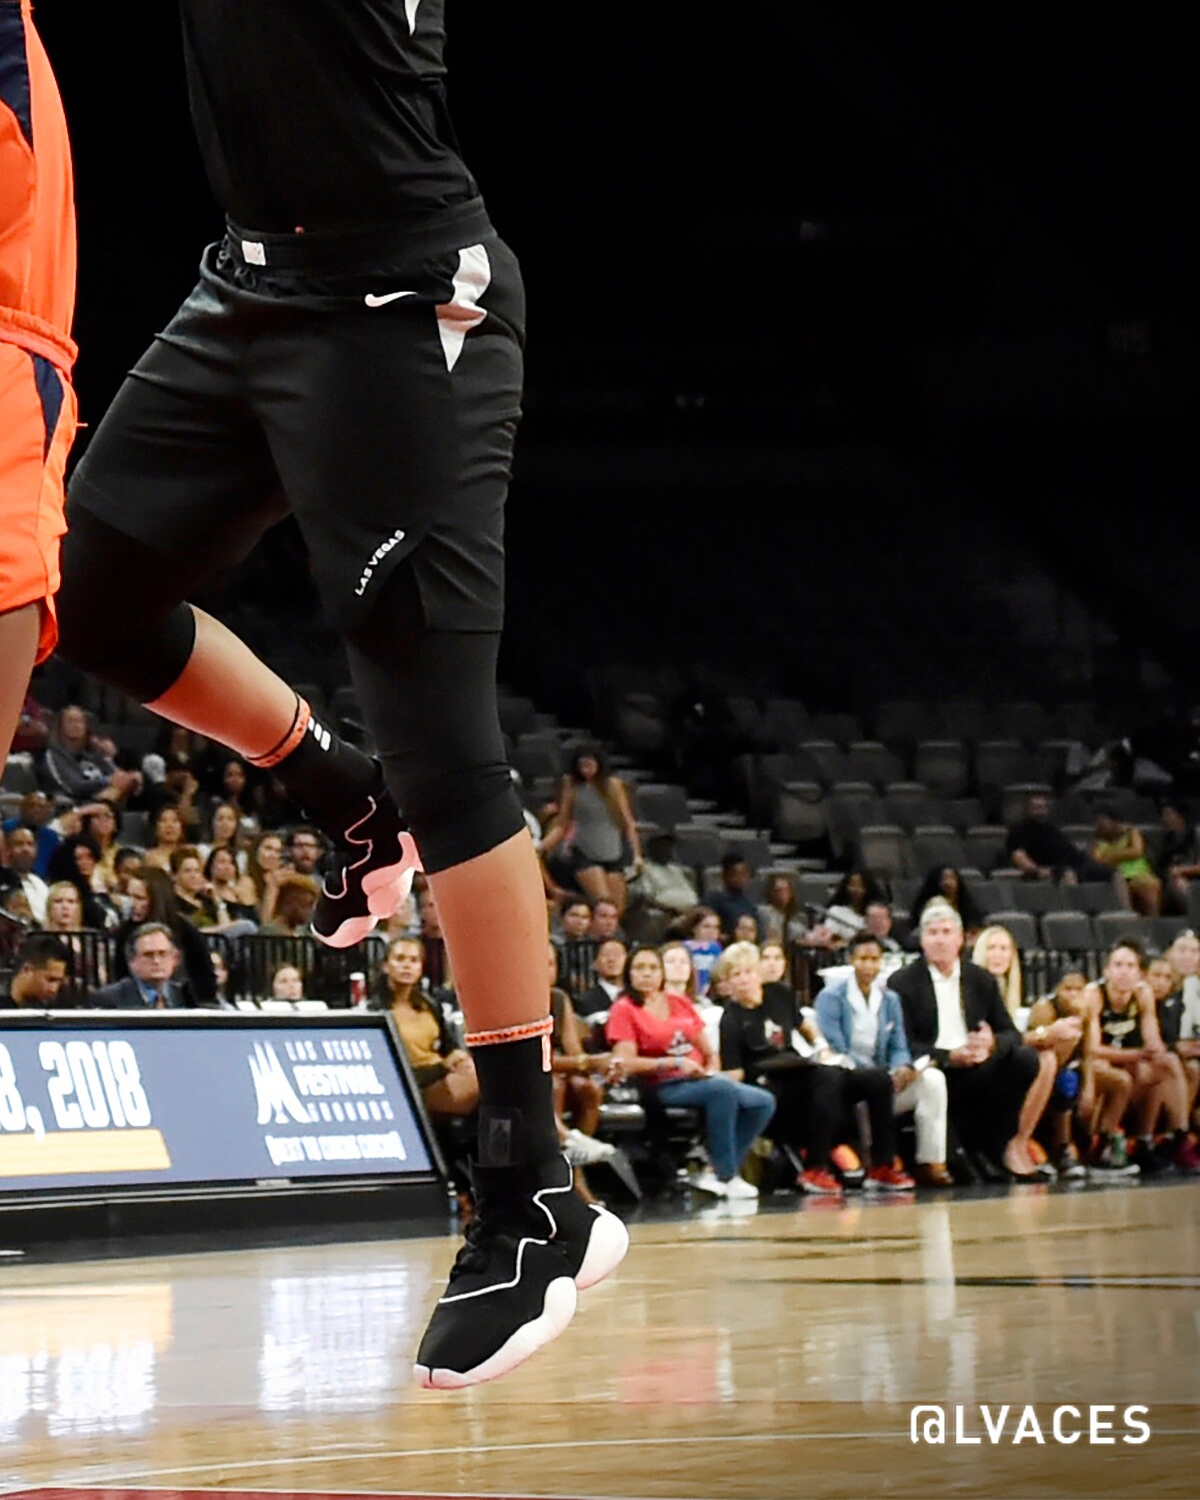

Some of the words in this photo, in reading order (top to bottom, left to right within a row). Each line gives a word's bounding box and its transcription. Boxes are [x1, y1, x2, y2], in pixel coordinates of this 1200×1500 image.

[354, 566, 374, 597] LAS
[367, 528, 406, 567] VEGAS
[38, 1040, 152, 1129] 2018
